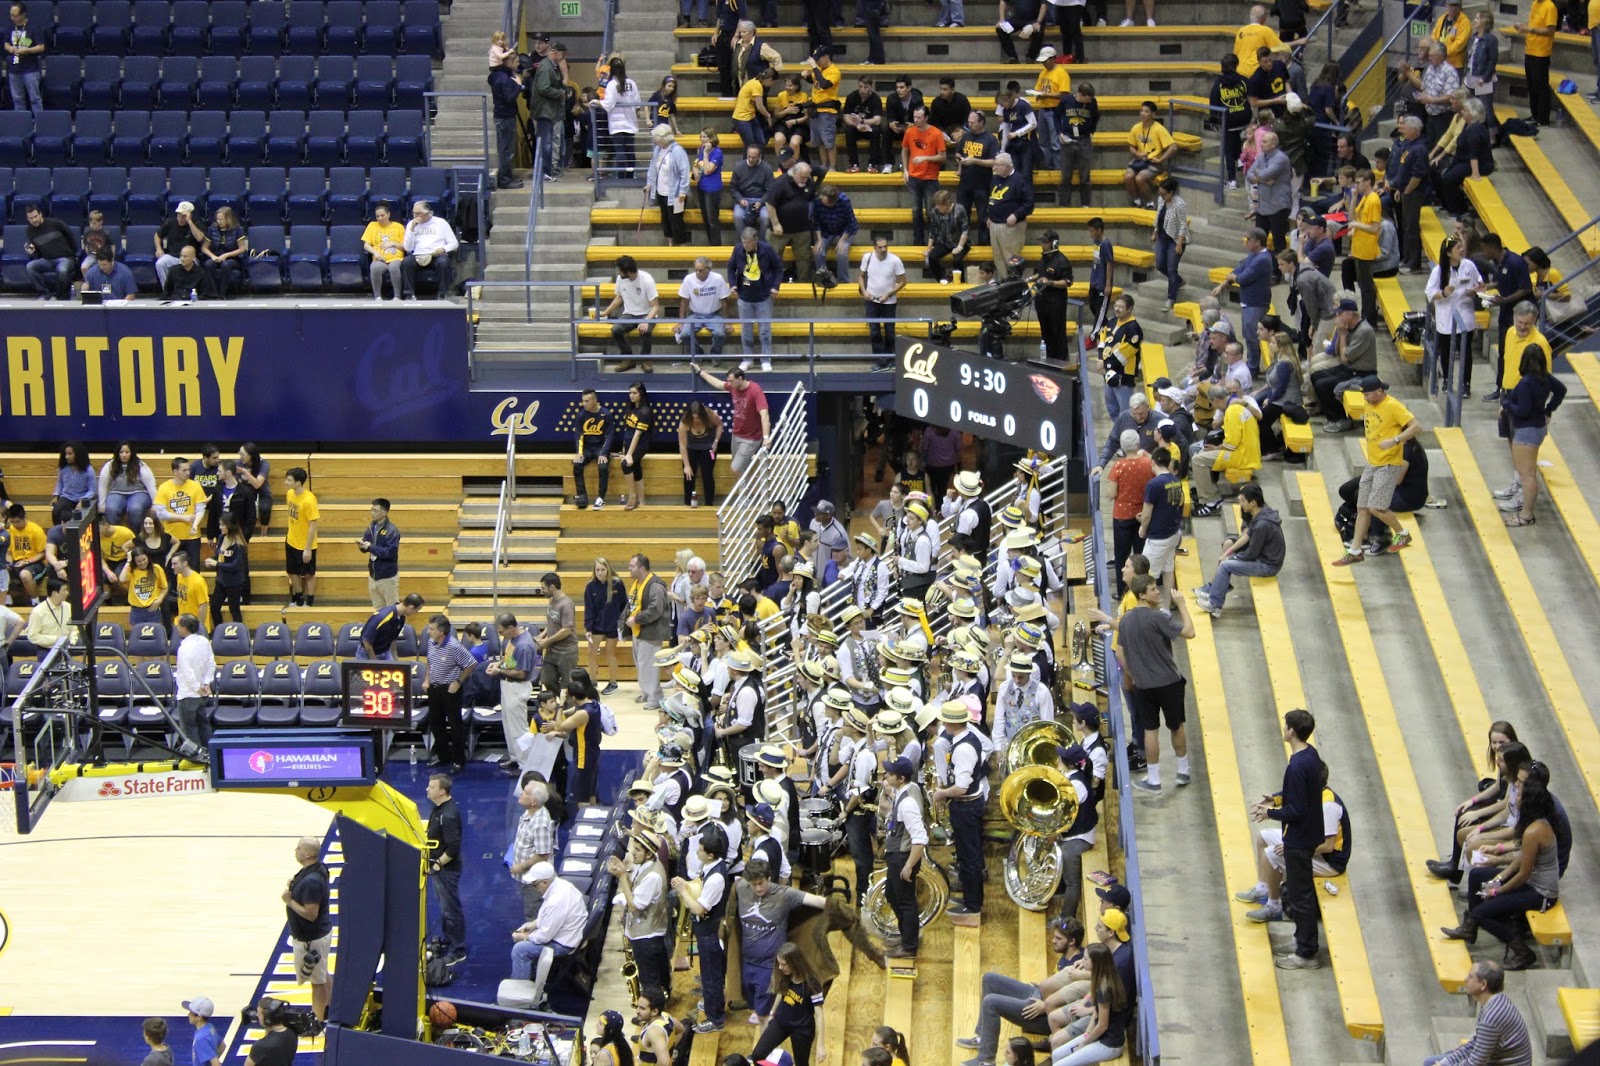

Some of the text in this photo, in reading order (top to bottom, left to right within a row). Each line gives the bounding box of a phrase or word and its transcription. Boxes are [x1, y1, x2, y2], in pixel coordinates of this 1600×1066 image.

[561, 3, 579, 15] EXIT
[1412, 23, 1428, 36] EXIT
[657, 104, 670, 118] Cal
[903, 343, 939, 384] Cal
[0, 336, 245, 417] RITORY
[960, 363, 1006, 394] 9:30
[913, 388, 929, 418] 0
[490, 396, 540, 436] Cal
[950, 400, 1016, 437] 0 FOULS 0
[583, 417, 605, 436] Cal
[1040, 420, 1056, 451] 0
[195, 475, 218, 483] BEARS
[100, 625, 113, 636] Cal
[141, 625, 154, 636] Cal
[225, 625, 239, 636] Cal
[267, 625, 280, 636] Cal
[308, 625, 322, 636] Cal
[20, 664, 32, 674] Cal
[104, 664, 118, 674] Cal
[147, 664, 160, 674] Cal
[232, 664, 246, 674] Cal
[275, 664, 288, 674] Cal
[318, 664, 332, 674] Cal
[362, 670, 404, 688] 9:29
[363, 691, 393, 715] 30
[275, 753, 337, 763] HAWAIIAN
[123, 776, 205, 795] State Farm
